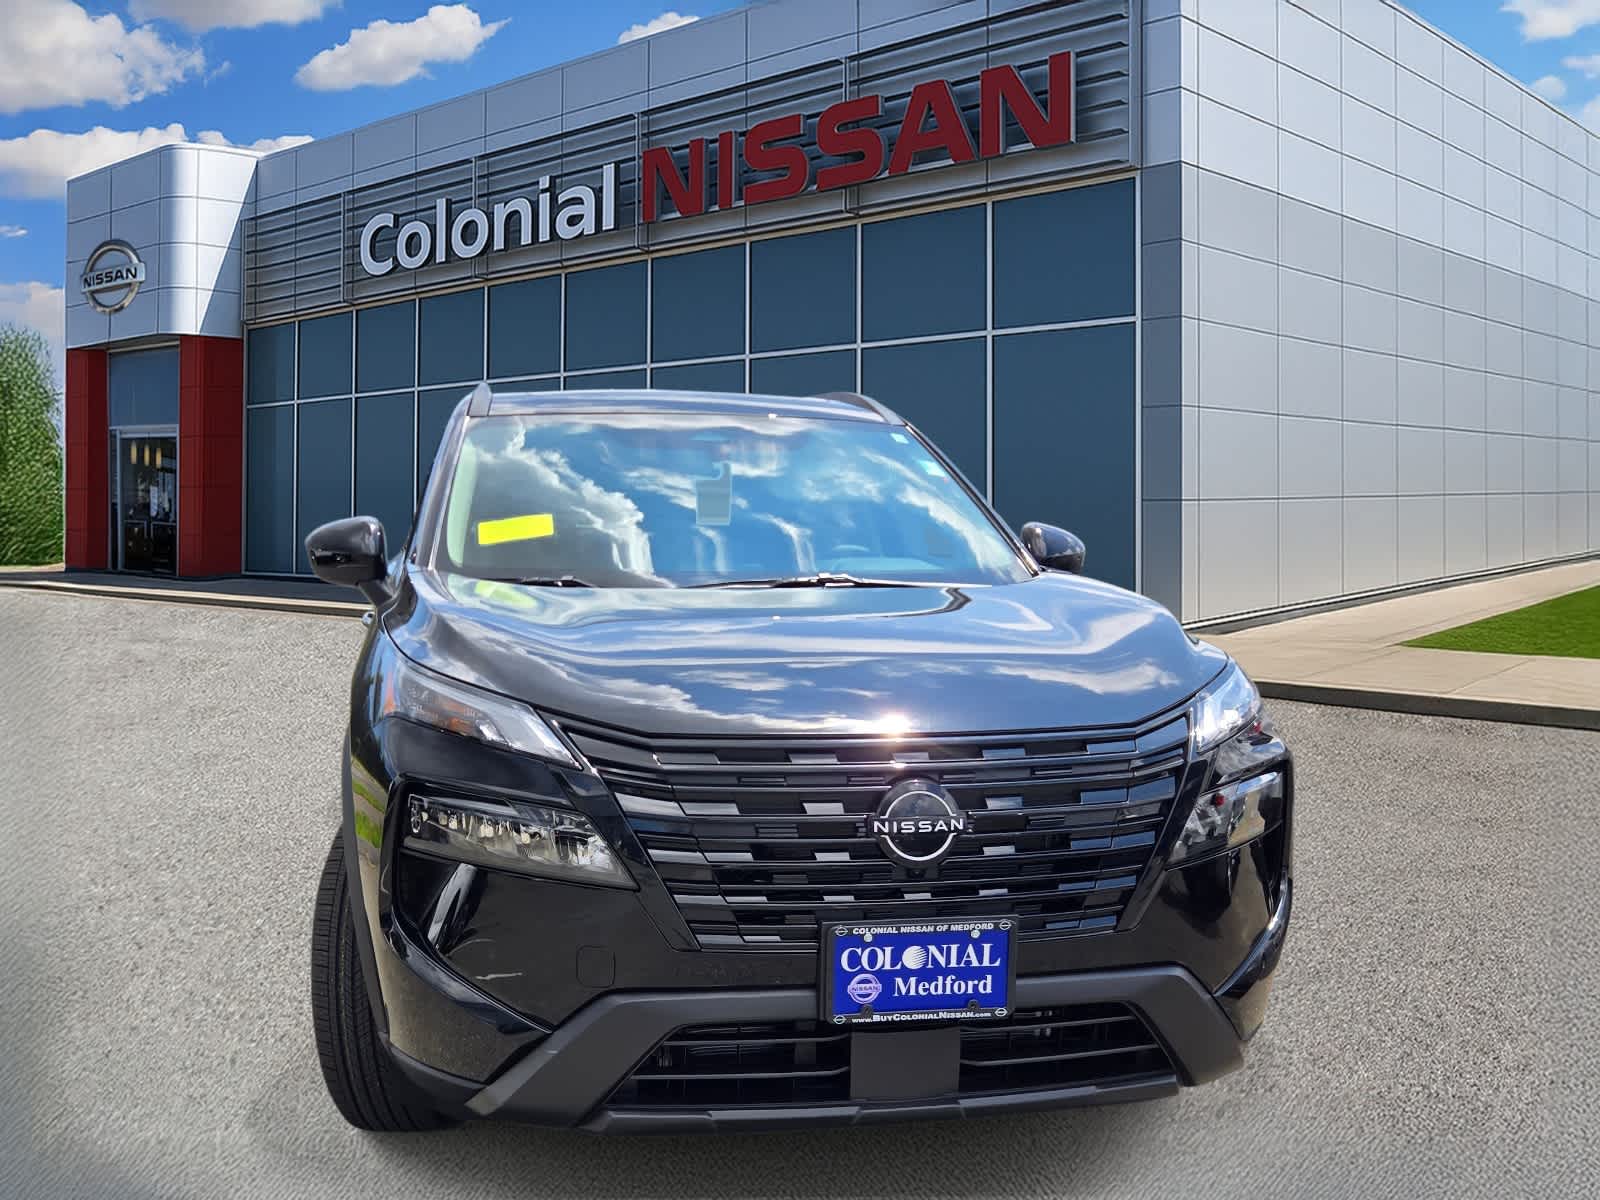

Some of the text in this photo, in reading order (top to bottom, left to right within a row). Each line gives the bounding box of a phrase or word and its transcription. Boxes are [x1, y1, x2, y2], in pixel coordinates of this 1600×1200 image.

[360, 51, 1077, 276] Colonial NISSAN
[83, 266, 138, 289] NISSAN
[873, 818, 964, 833] NISSAN
[852, 925, 898, 935] COLONIAL
[900, 924, 934, 934] NISSAN
[936, 924, 948, 932] OF
[950, 922, 994, 931] MEDFORD
[892, 974, 993, 997] Medford
